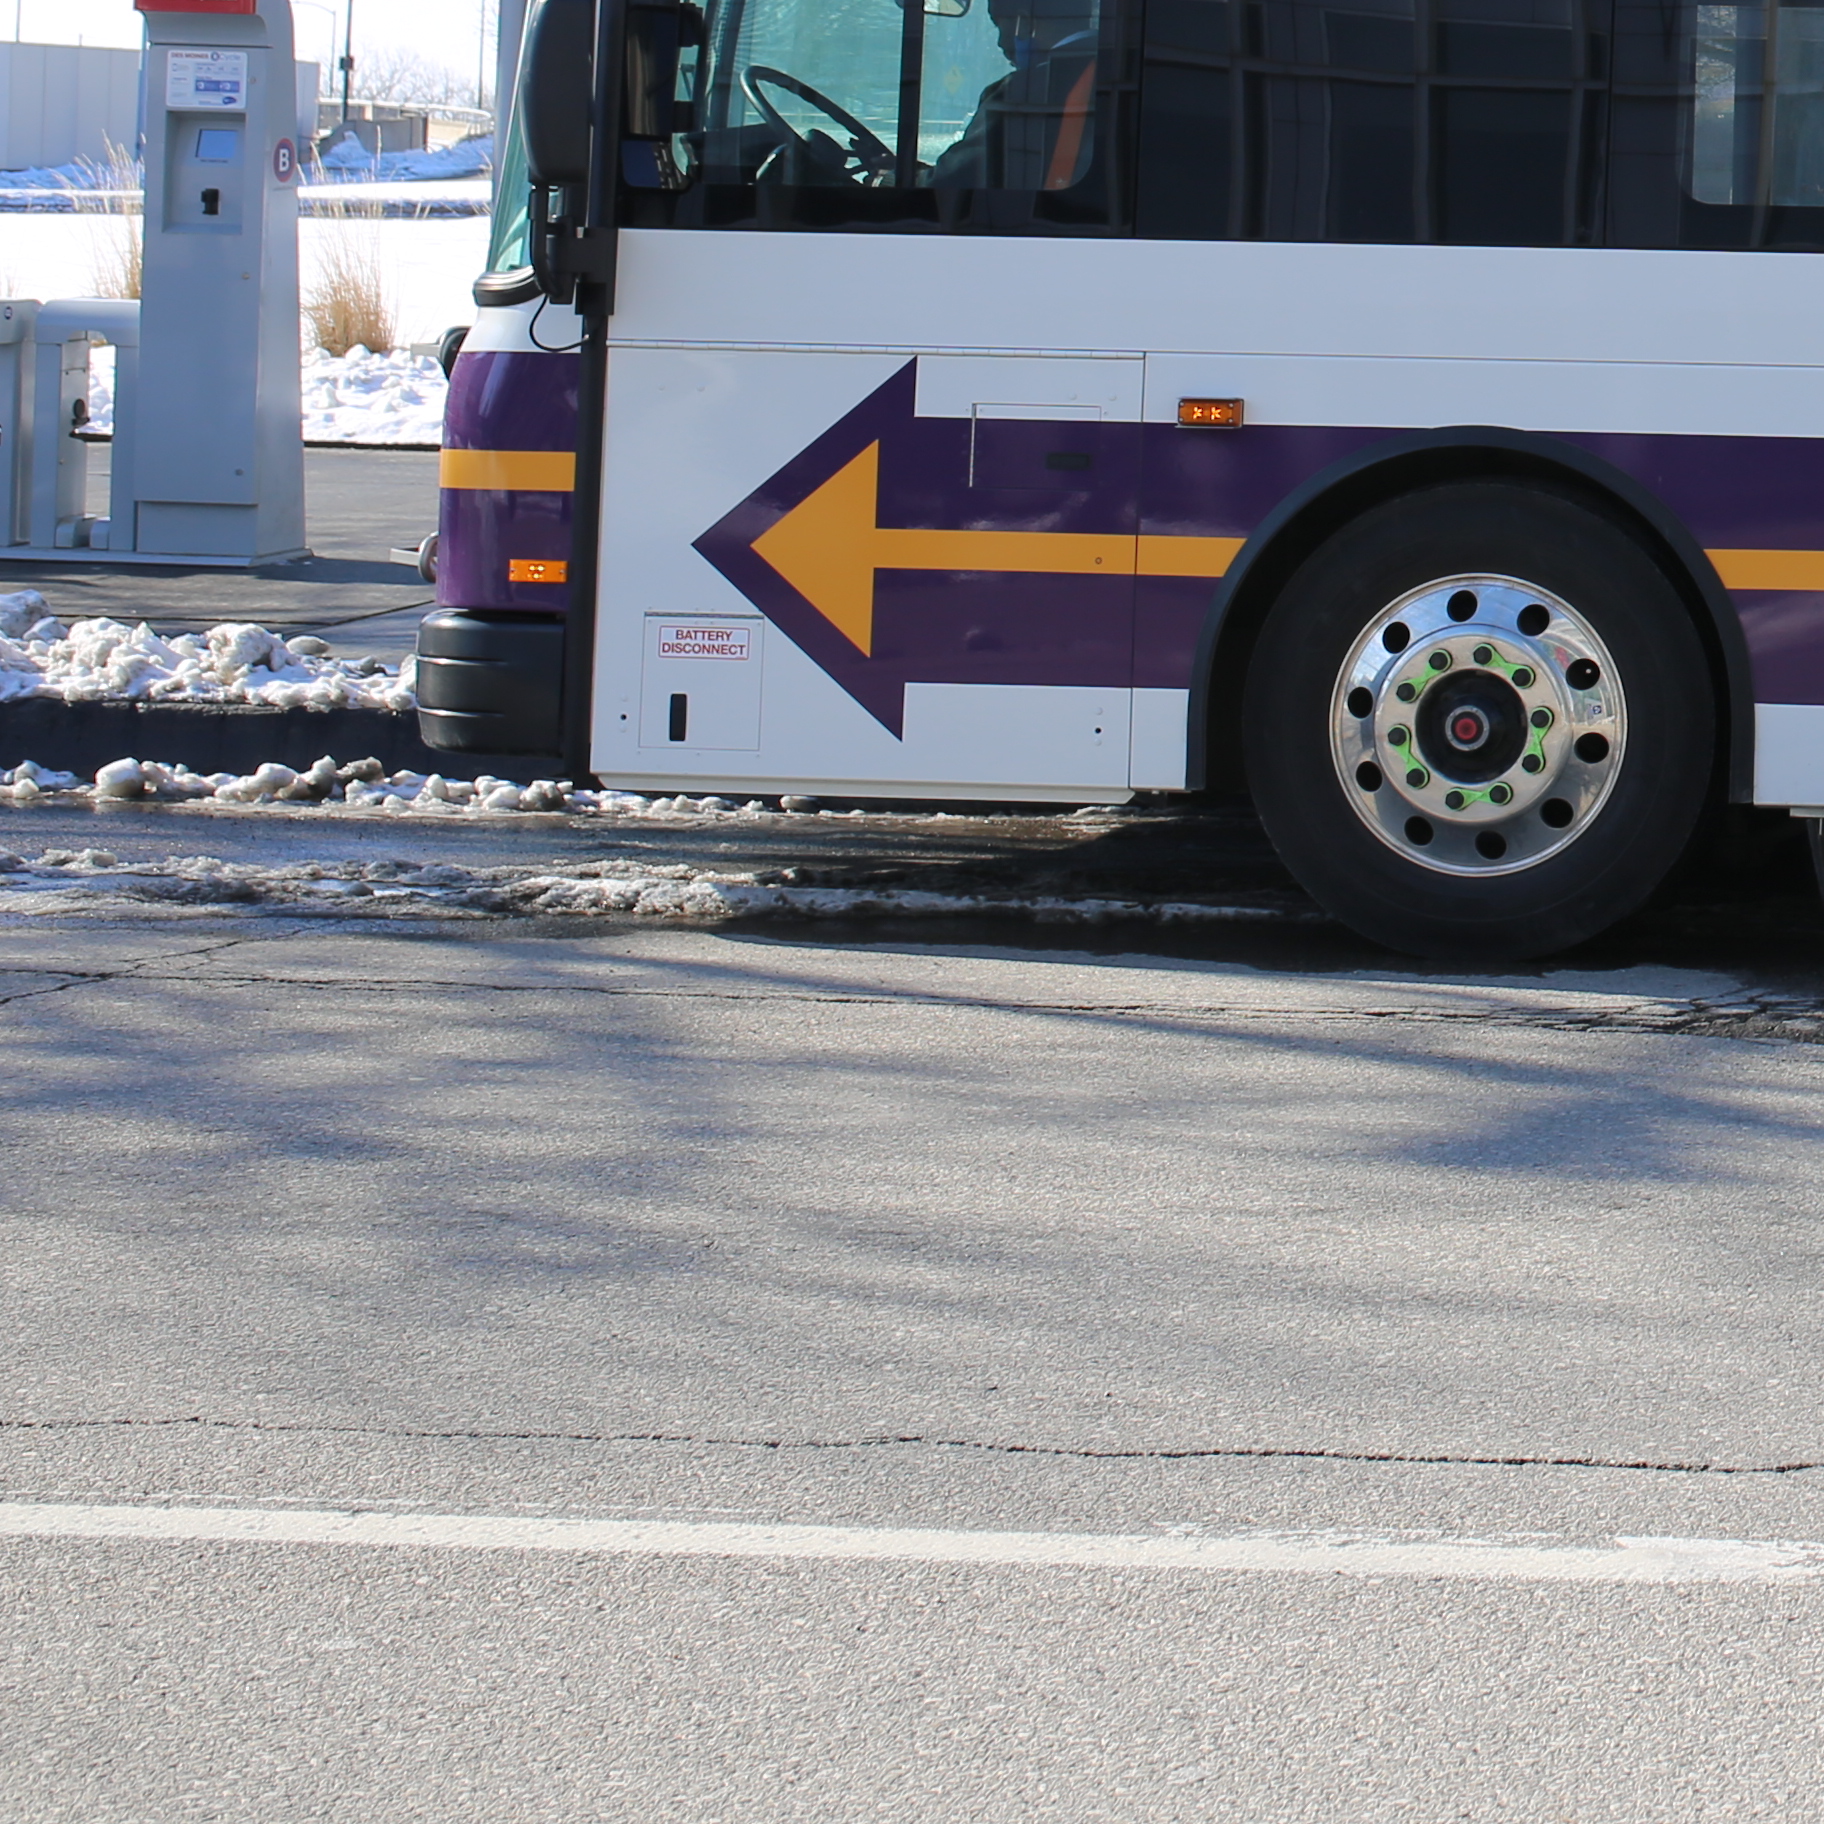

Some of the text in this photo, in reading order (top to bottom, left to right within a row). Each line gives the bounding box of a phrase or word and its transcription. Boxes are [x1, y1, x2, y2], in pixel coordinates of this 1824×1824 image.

[279, 148, 290, 172] B
[675, 629, 734, 641] BATTERY
[662, 642, 747, 655] DISCONNECT
